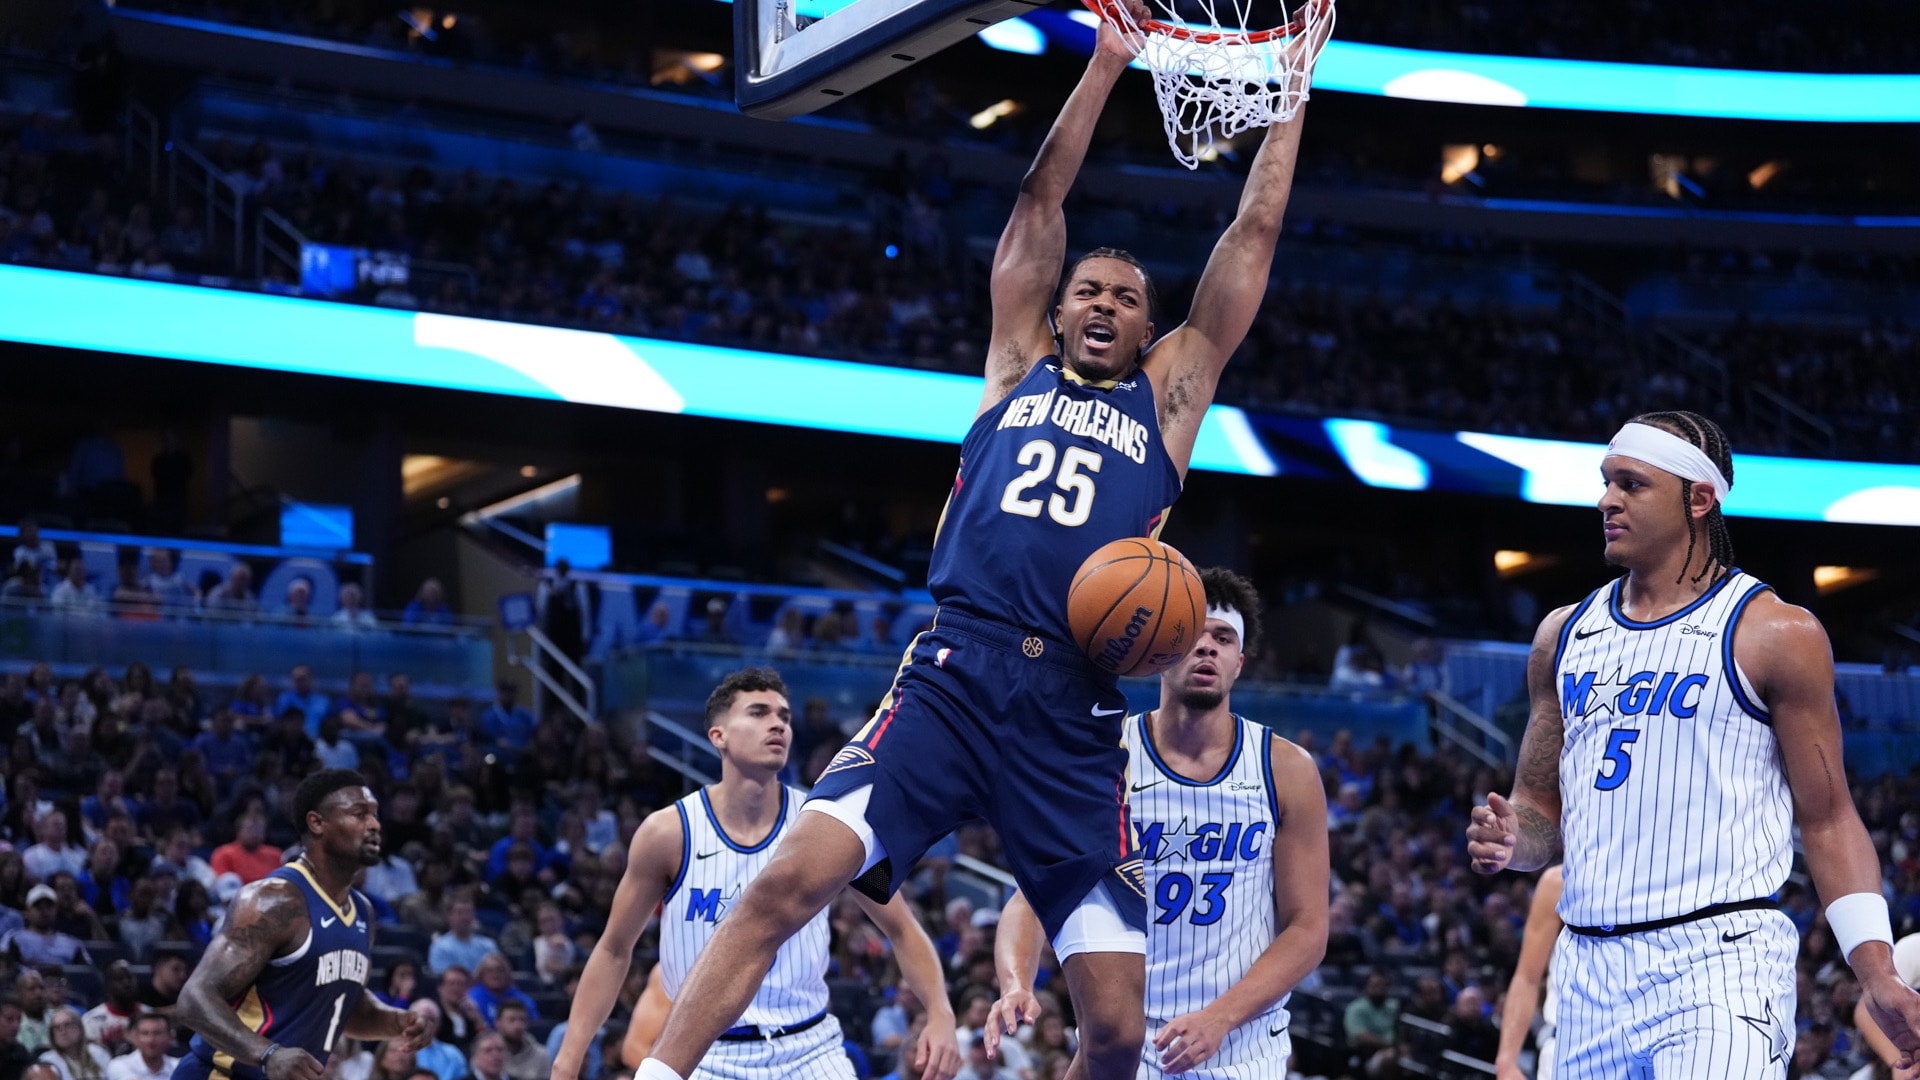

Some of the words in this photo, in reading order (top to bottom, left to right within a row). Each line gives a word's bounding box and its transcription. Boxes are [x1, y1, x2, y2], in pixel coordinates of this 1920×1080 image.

[997, 387, 1058, 431] NEW
[1051, 395, 1149, 465] ORLEANS
[1000, 439, 1103, 527] 25
[1093, 605, 1153, 672] Wilson
[1680, 623, 1718, 641] Disney
[1225, 781, 1262, 793] Disney
[1594, 728, 1641, 791] 5
[1153, 872, 1235, 926] 93
[315, 950, 341, 987] NEW
[323, 993, 346, 1052] 1
